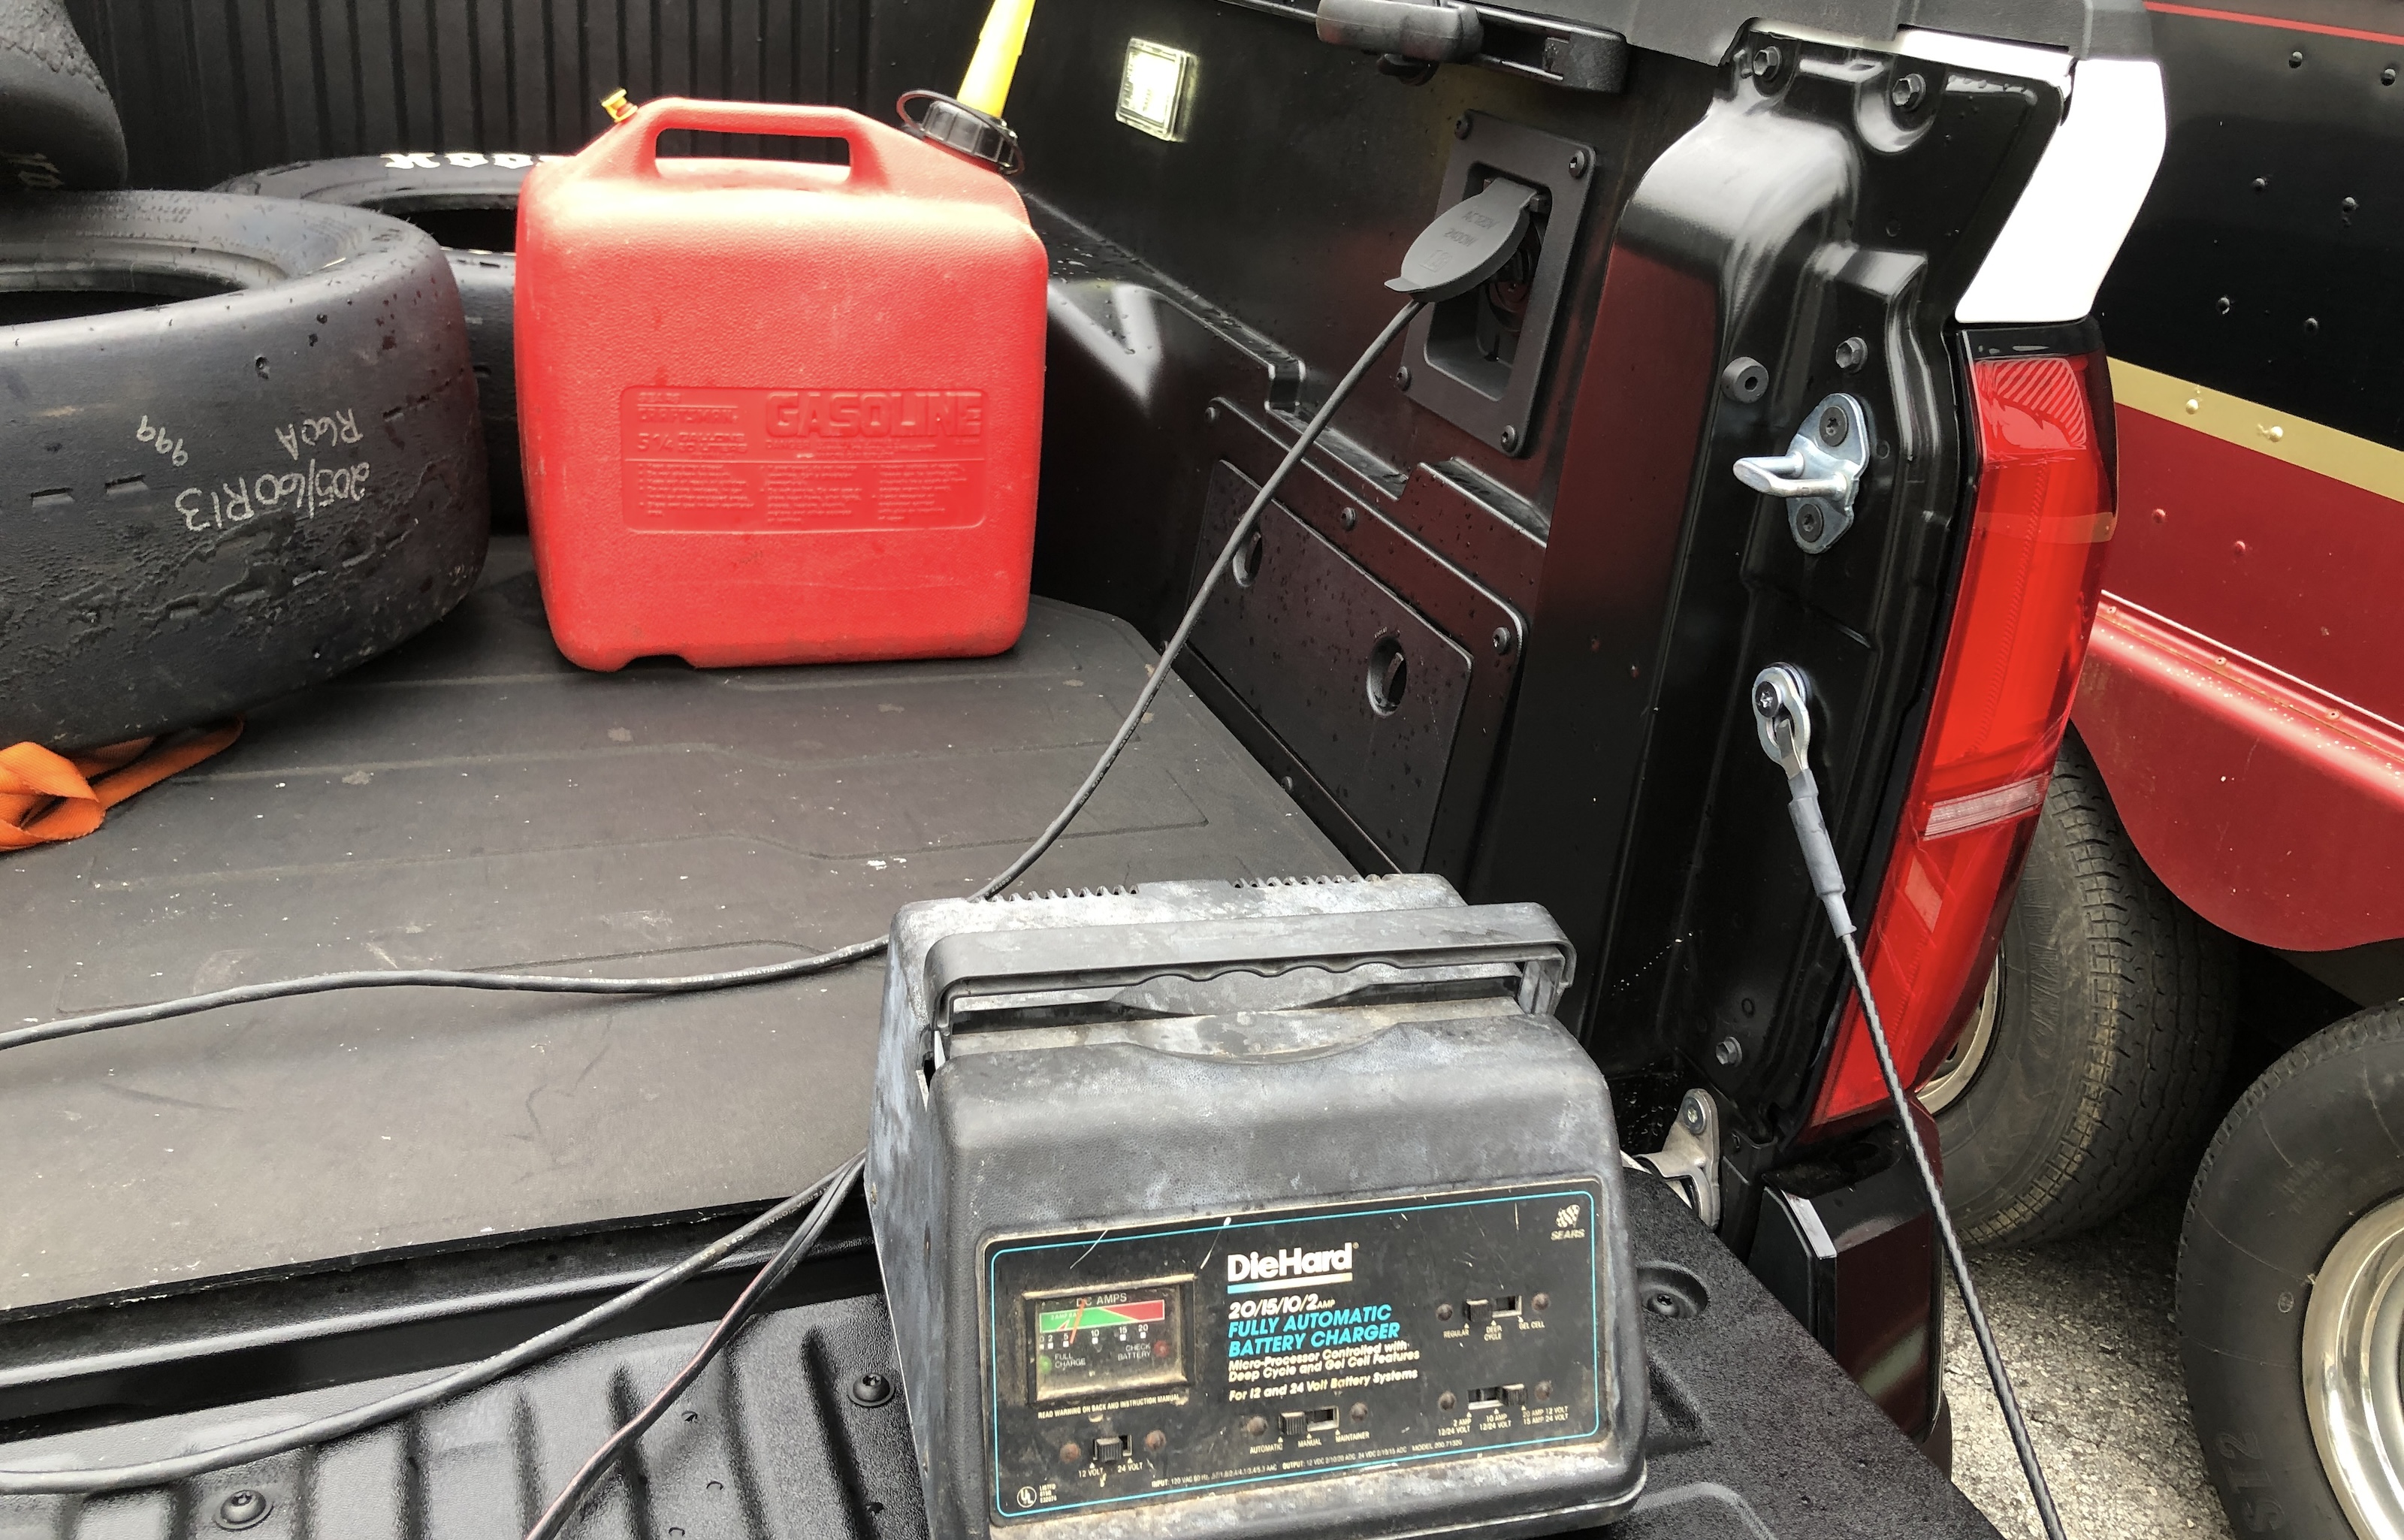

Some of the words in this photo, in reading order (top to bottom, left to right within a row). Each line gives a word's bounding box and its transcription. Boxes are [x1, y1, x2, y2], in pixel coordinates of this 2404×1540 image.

[766, 391, 982, 438] GASOLINE
[175, 458, 370, 532] 205/60R13
[722, 964, 794, 979] INTERNATIONAL
[1551, 1228, 1585, 1241] SEARS
[1228, 1243, 1352, 1282] DieHard
[1096, 1292, 1127, 1306] AMPS
[1228, 1317, 1279, 1338] FULLY
[1283, 1304, 1392, 1333] AUTOMATIC
[1518, 1322, 1530, 1330] GEL
[1531, 1321, 1545, 1329] CELL
[1138, 1324, 1149, 1332] 20
[1228, 1333, 1306, 1357] BATTERY
[1310, 1321, 1400, 1348] CHARGER
[1443, 1329, 1469, 1339] REGULAR
[1484, 1333, 1502, 1341] CYCLE
[1125, 1344, 1151, 1352] CHECK
[1118, 1351, 1152, 1361] BATTERY
[1228, 1351, 1320, 1372] Micro-Processor
[1322, 1342, 1382, 1360] Controlled
[1385, 1340, 1408, 1353] with
[1055, 1357, 1086, 1369] CHARGE
[1228, 1369, 1260, 1382] Deep
[1263, 1364, 1297, 1379] Cycle
[1300, 1360, 1322, 1373] and
[1325, 1357, 1345, 1370] Gel
[1348, 1354, 1370, 1368] Cell
[1373, 1350, 1421, 1365] Features
[1229, 1389, 1247, 1402] For
[1249, 1388, 1261, 1399] 12
[1264, 1383, 1287, 1397] and
[1290, 1382, 1303, 1394] 24
[1306, 1378, 1328, 1392] Volt
[1330, 1375, 1370, 1389] Battery
[1373, 1369, 1418, 1384] Systems
[1037, 1410, 1053, 1419] READ
[1054, 1406, 1081, 1418] WARNING
[1083, 1405, 1091, 1413] ON
[1092, 1403, 1107, 1412] BACK
[1107, 1402, 1119, 1410] AND
[1120, 1397, 1156, 1409] INSTRUCTION
[1157, 1394, 1179, 1403] MANUAL
[1531, 1409, 1544, 1417] AMP
[1545, 1407, 1553, 1415] 12
[1554, 1406, 1568, 1414] VOLT
[1458, 1418, 1472, 1426] AMP
[1493, 1414, 1508, 1422] AMP
[1530, 1416, 1545, 1424] AMP
[1554, 1414, 1568, 1422] VOLT
[1479, 1422, 1496, 1430] 12/24
[1497, 1420, 1512, 1428] VOLT
[1335, 1431, 1370, 1443] MAINTAINER
[1438, 1428, 1455, 1436] 12/24
[1249, 1443, 1283, 1454] AUTOMATIC
[1298, 1438, 1322, 1448] MANUAL
[1412, 1442, 1433, 1452] MODEL
[1088, 1467, 1104, 1477] VOLT
[1117, 1464, 1126, 1472] 24
[1127, 1462, 1143, 1471] VOLT
